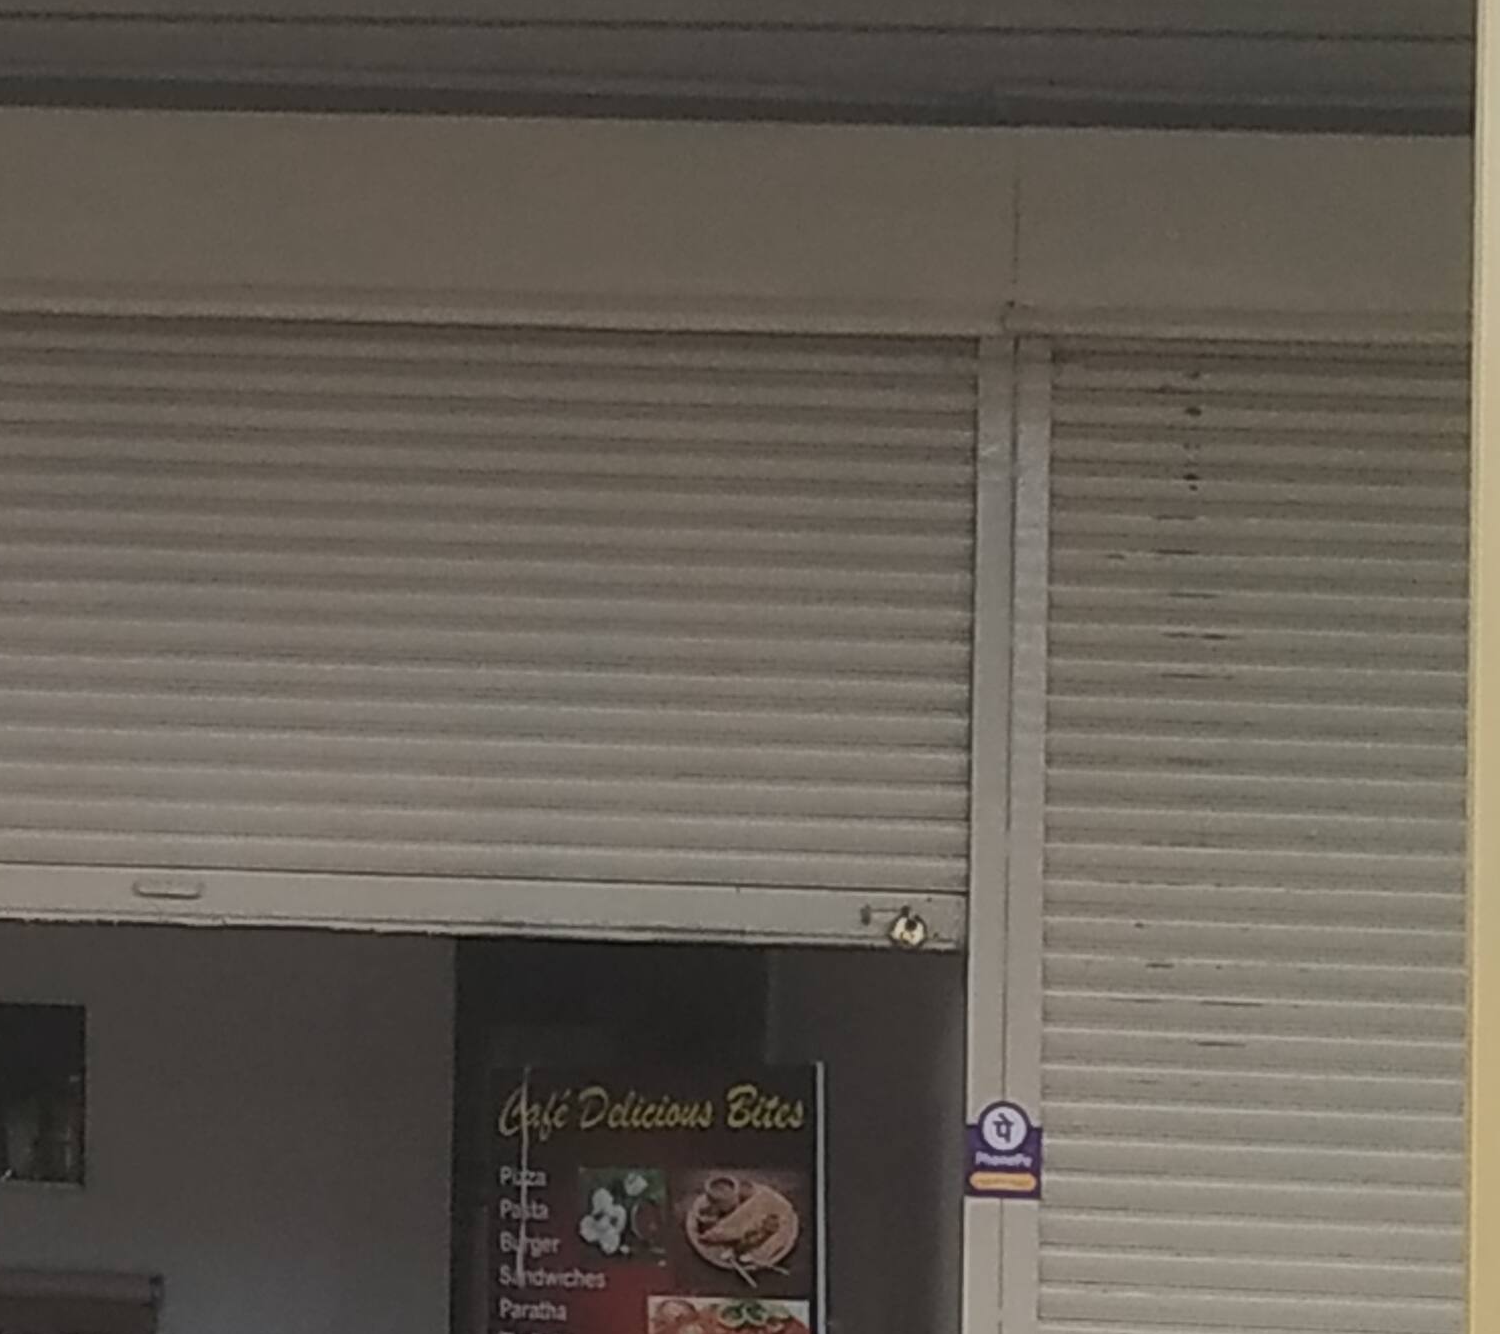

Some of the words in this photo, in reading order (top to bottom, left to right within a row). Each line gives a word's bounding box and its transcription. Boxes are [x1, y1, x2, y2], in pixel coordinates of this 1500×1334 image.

[500, 1088, 571, 1140] Café
[579, 1087, 714, 1130] Delicious
[726, 1084, 804, 1129] Bites
[500, 1299, 567, 1321] Paratha
